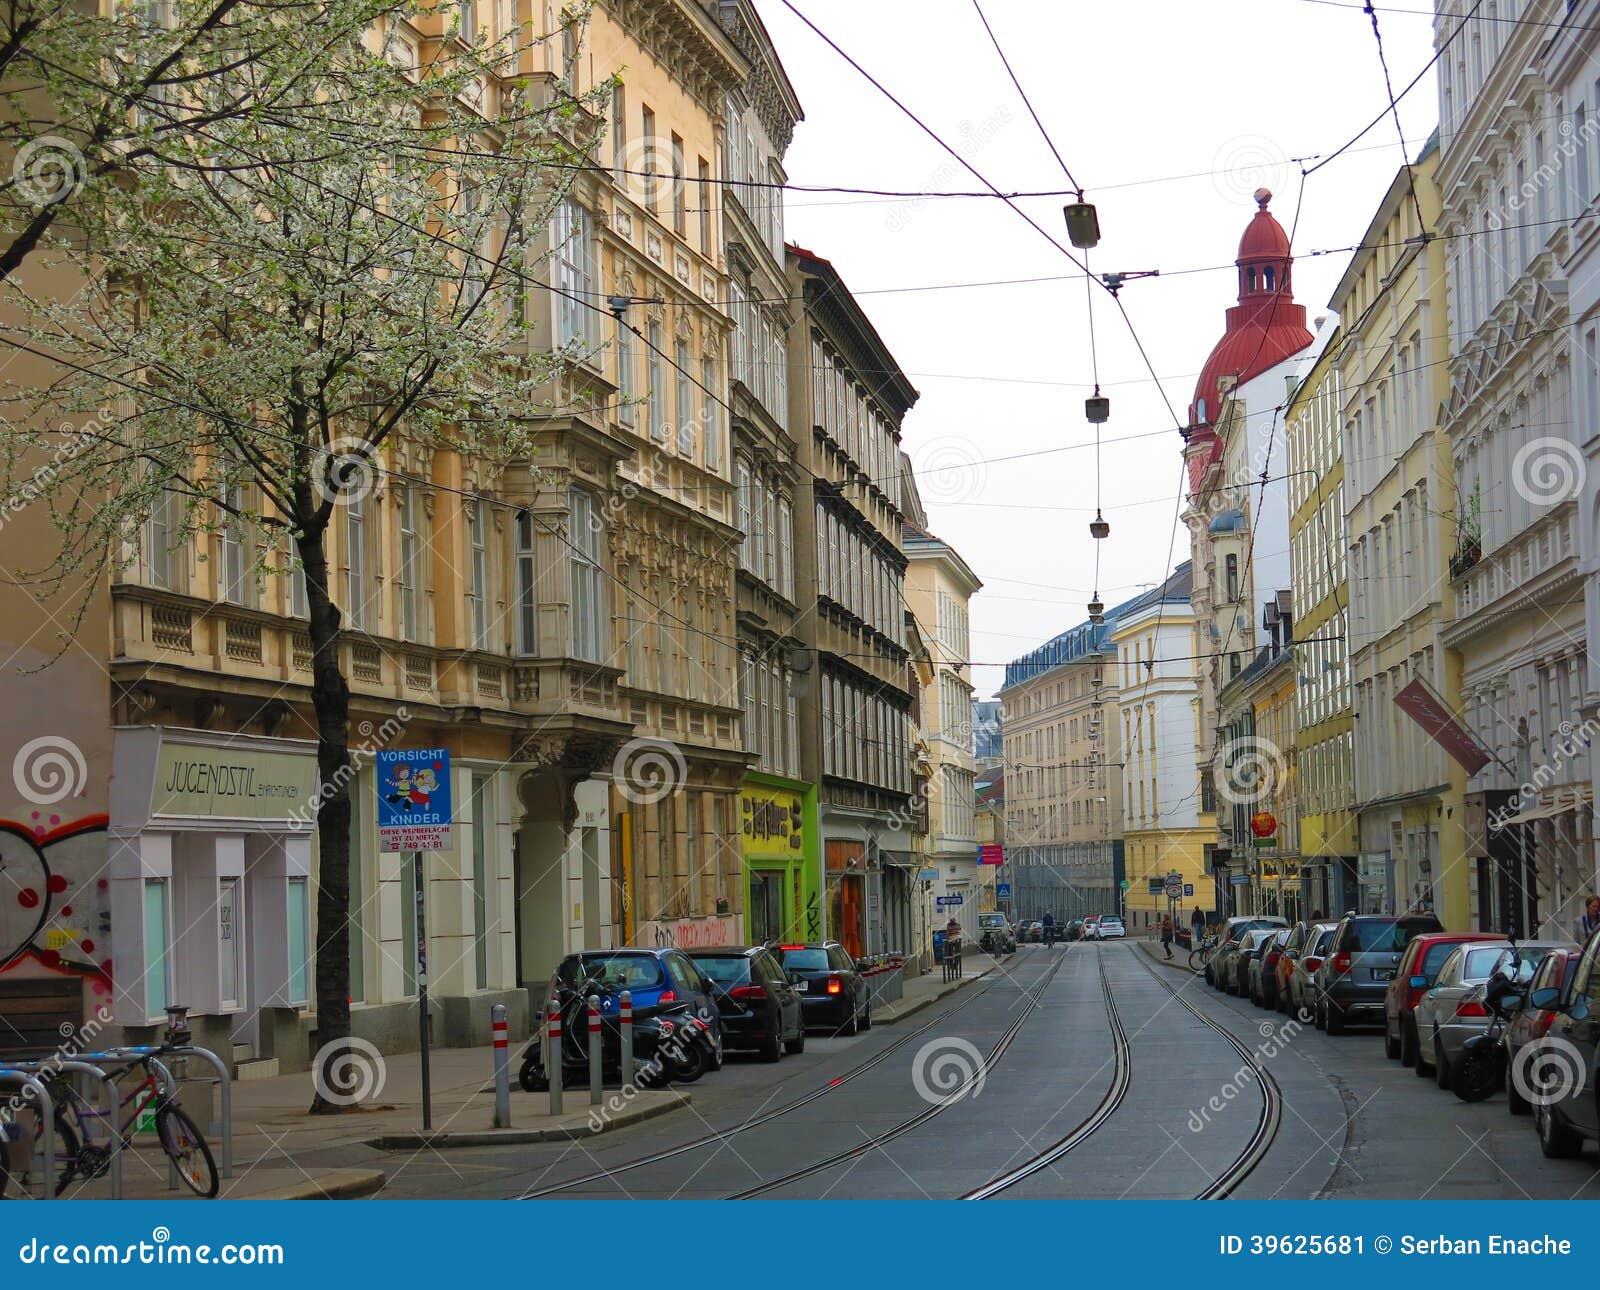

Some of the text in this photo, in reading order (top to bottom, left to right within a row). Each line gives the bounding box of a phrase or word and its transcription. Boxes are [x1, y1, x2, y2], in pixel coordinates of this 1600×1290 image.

[381, 750, 444, 761] VORSICHT
[166, 761, 256, 797] JUGENDSTIL
[390, 813, 440, 825] KINDER
[380, 828, 400, 836] DIESE
